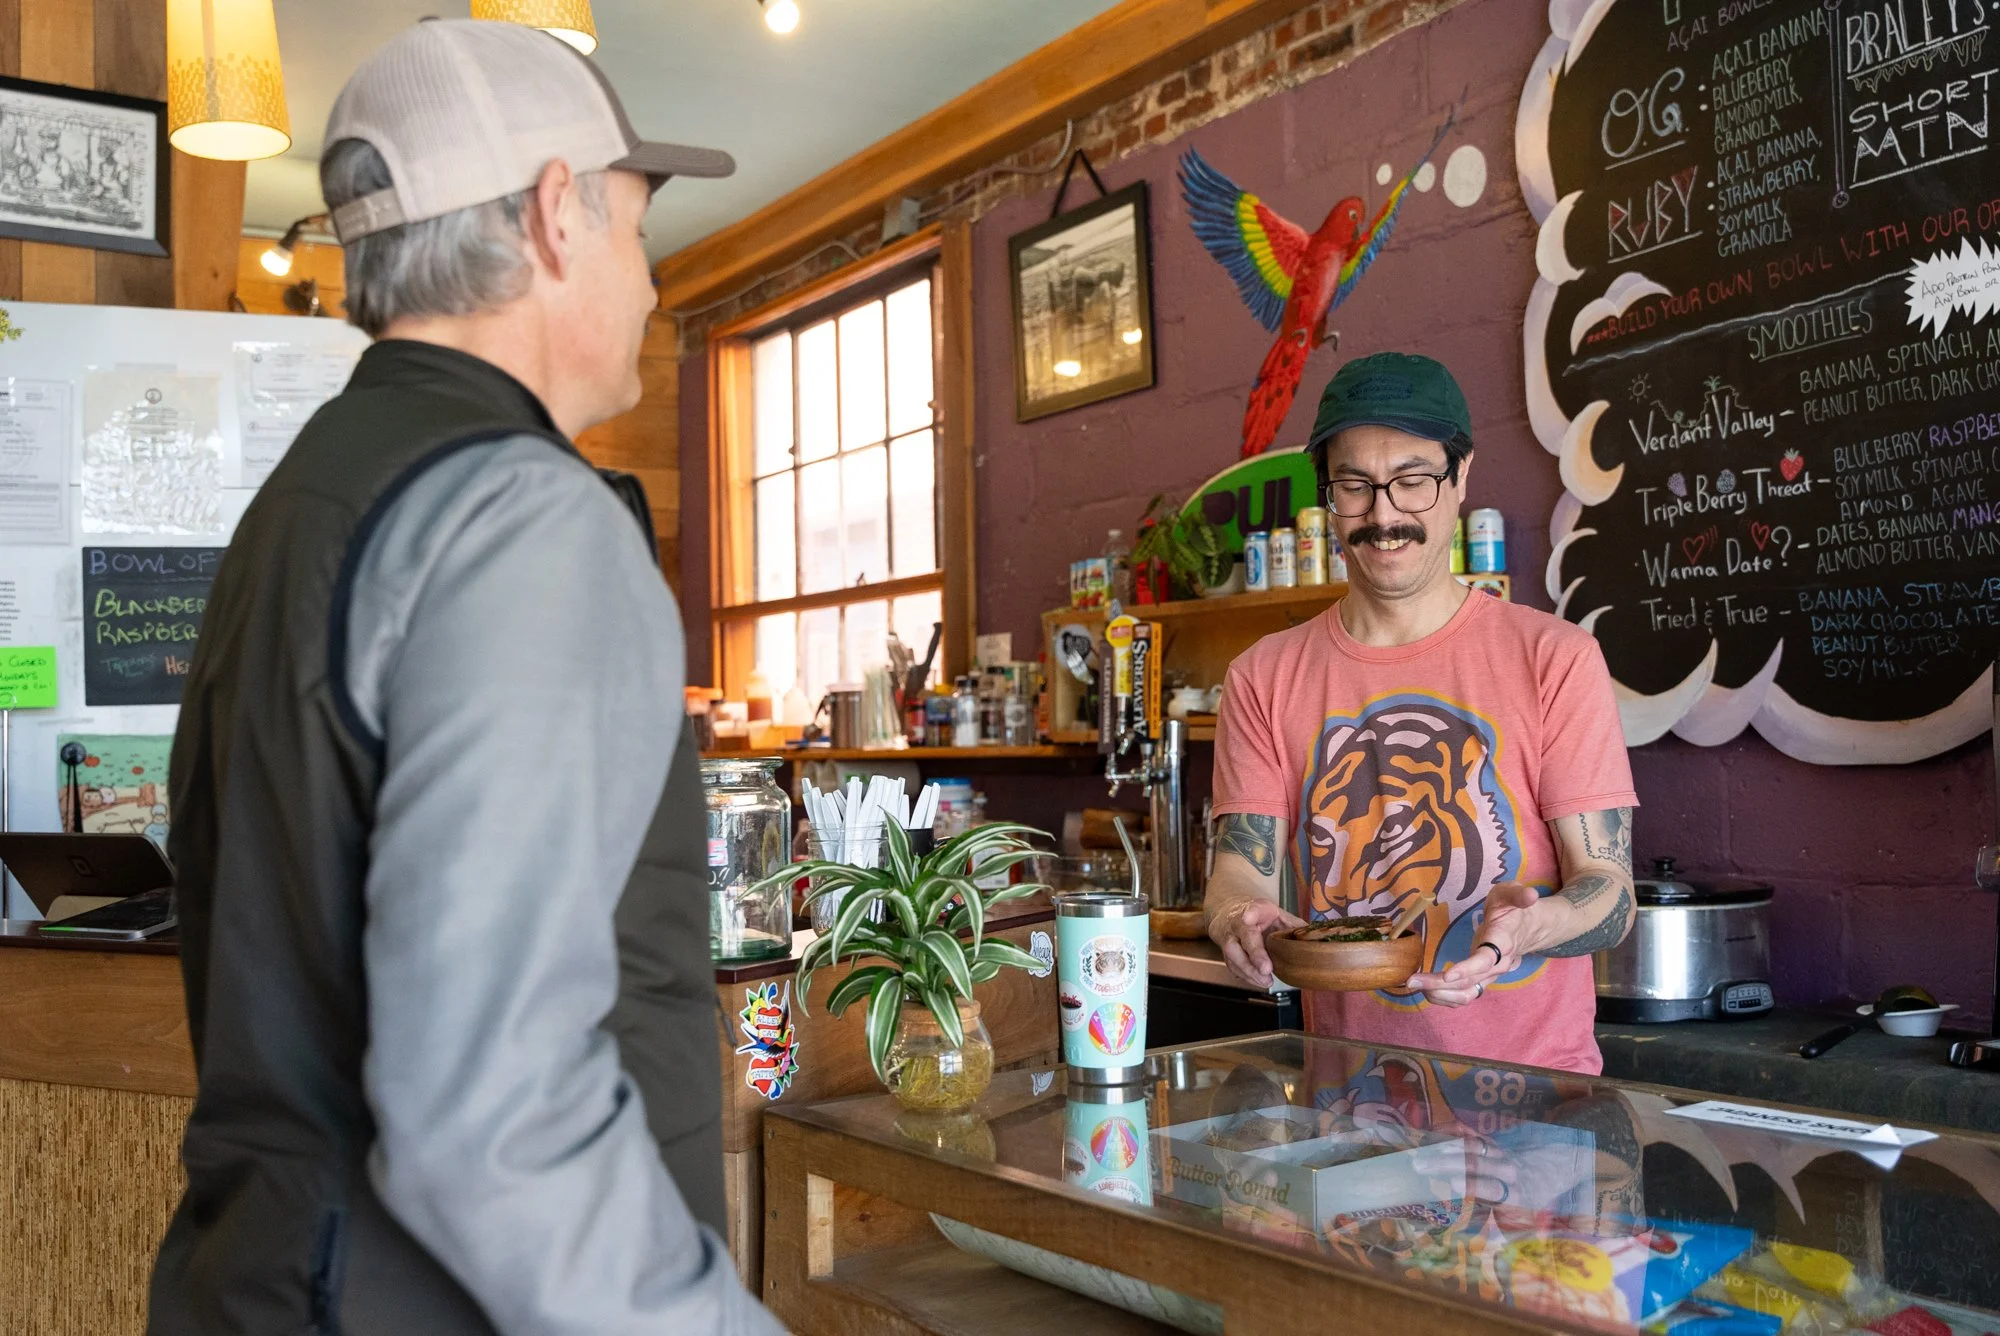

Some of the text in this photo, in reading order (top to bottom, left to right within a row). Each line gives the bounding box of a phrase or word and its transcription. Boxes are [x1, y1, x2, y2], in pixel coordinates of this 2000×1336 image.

[1717, 0, 1773, 27] BOWL
[1712, 54, 1794, 110] BLUEBERRY,
[1849, 68, 1999, 132] SHORT
[1714, 114, 1781, 154] GRANOLA
[1757, 126, 1823, 170] BANANA,
[1853, 93, 1988, 182] MTN
[1718, 155, 1821, 212] STRAWBERRY,
[1718, 221, 1793, 257] GRANOLA
[1660, 288, 1703, 320] YOUR
[1707, 269, 1753, 304] OWN
[1767, 246, 1833, 288] BOWL
[1840, 221, 1910, 260] WITH
[1922, 208, 1970, 243] OUR
[1921, 280, 1945, 299] ADD
[1935, 293, 1953, 309] ANY
[1957, 284, 1980, 298] BOWL
[1748, 297, 1873, 360] SMOOTHIES
[1800, 354, 1881, 394] BANANA,
[1888, 330, 1980, 374] SPINACH,
[1803, 390, 1859, 425] PEANUT
[1866, 376, 1927, 412] BUTTER,
[1931, 367, 1974, 400] DARK
[1629, 410, 1712, 455] Verdant
[1712, 394, 1776, 438] Valley
[1833, 412, 2000, 472] BLUEBERRY, RASPBE
[1835, 473, 1860, 499] SOY
[1911, 449, 1989, 485] SPINACH,
[1932, 478, 1988, 508] AGAVE
[1635, 487, 1693, 527] Triple
[1696, 474, 1747, 515] Berry
[1742, 468, 1812, 504] Threat
[1817, 520, 1874, 546] DATES,
[1817, 530, 2000, 574] ALMOND BUTTER, VAN
[90, 550, 217, 575] BOWL OF
[1643, 542, 1718, 588] Wanna
[1640, 597, 1697, 632] Tried
[1716, 595, 1768, 626] True
[1799, 586, 1899, 612] BANANA,
[1811, 613, 1864, 632] DARK
[1812, 635, 1879, 655] PEANUT
[1132, 639, 1148, 737] ALEWERKS
[1824, 657, 1928, 684] SOY MILK
[761, 1030, 777, 1038] CAT
[1166, 1155, 1292, 1205] Butter Pound
